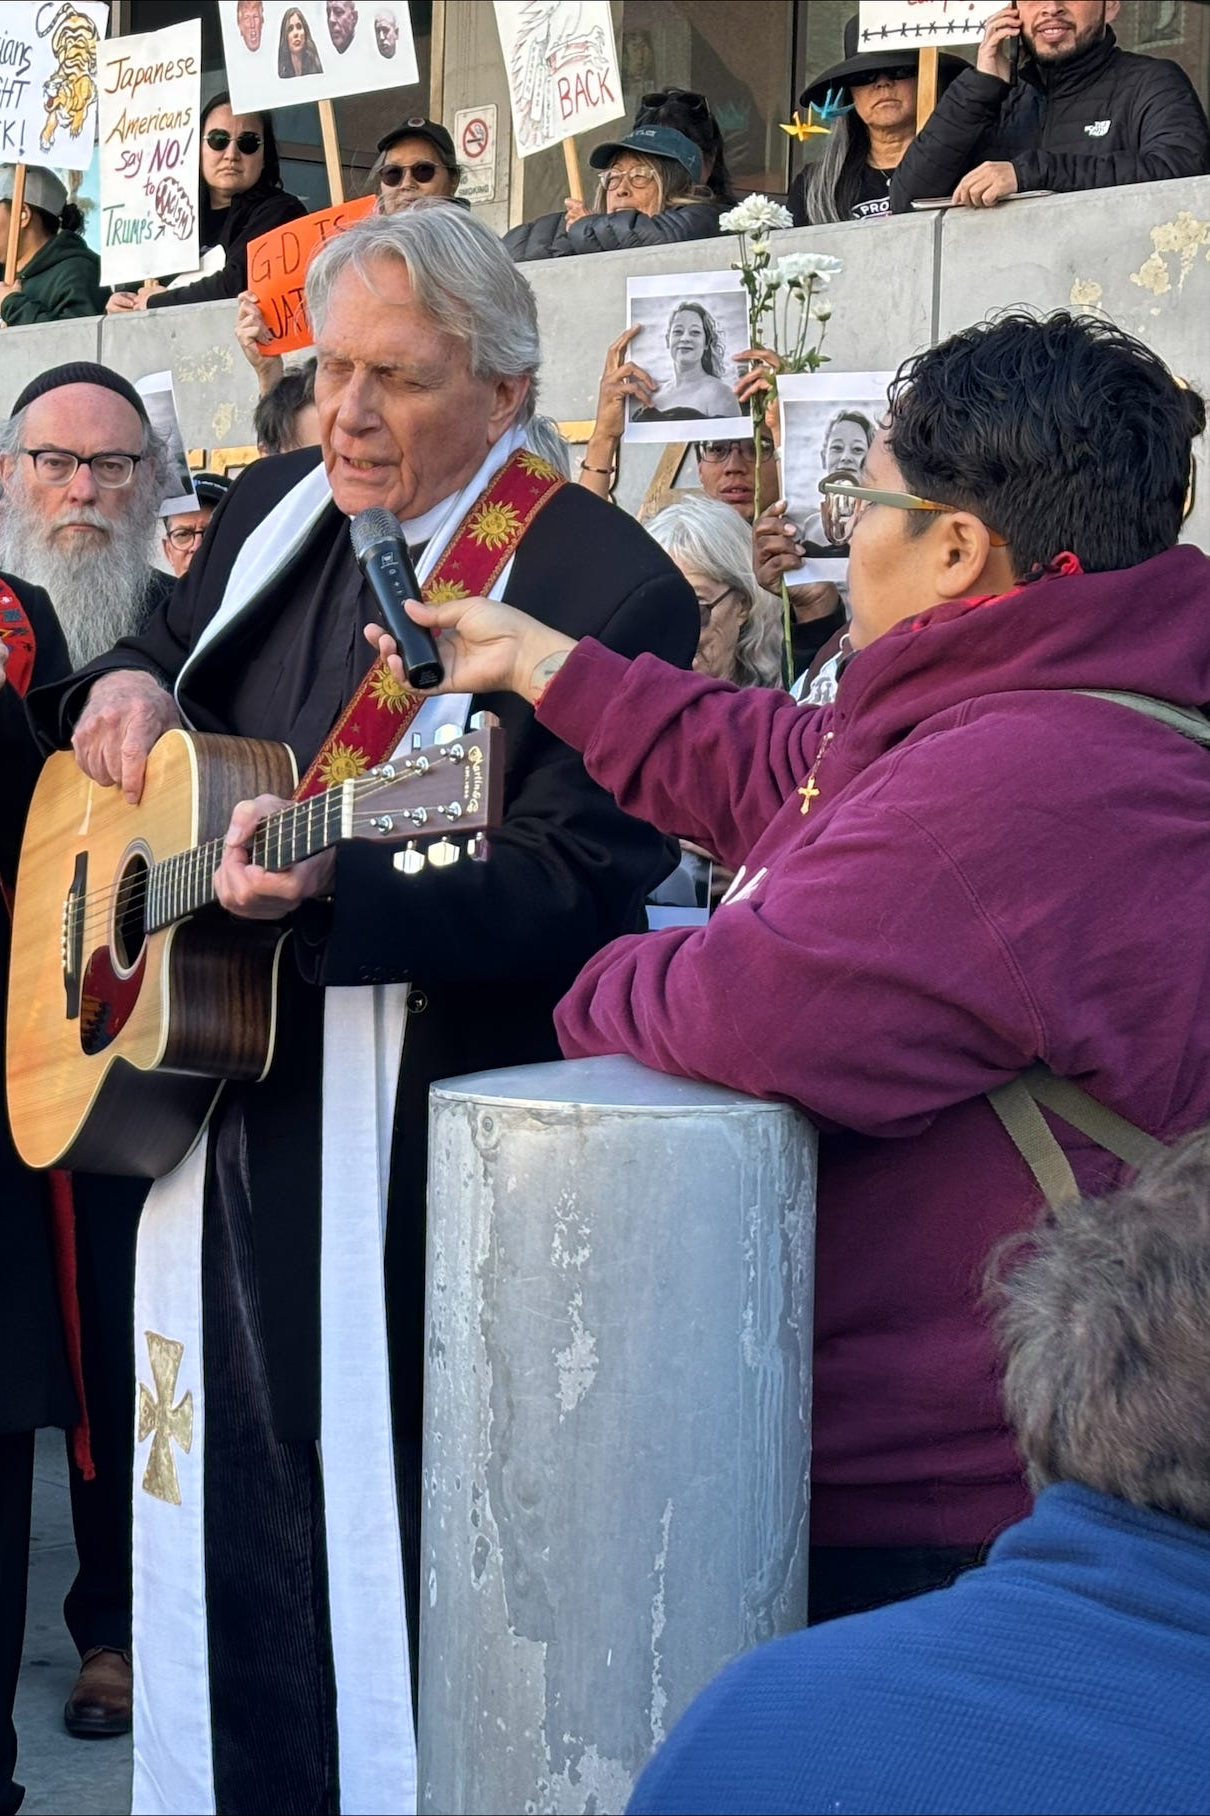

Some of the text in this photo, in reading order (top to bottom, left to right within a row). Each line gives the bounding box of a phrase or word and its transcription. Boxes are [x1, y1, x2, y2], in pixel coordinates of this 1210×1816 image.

[104, 55, 198, 99] Japanese
[557, 67, 615, 120] BACK
[105, 107, 193, 145] Americans
[115, 127, 194, 179] say NO!
[143, 176, 157, 196] to
[156, 183, 190, 234] RACISM
[251, 231, 301, 283] G-D
